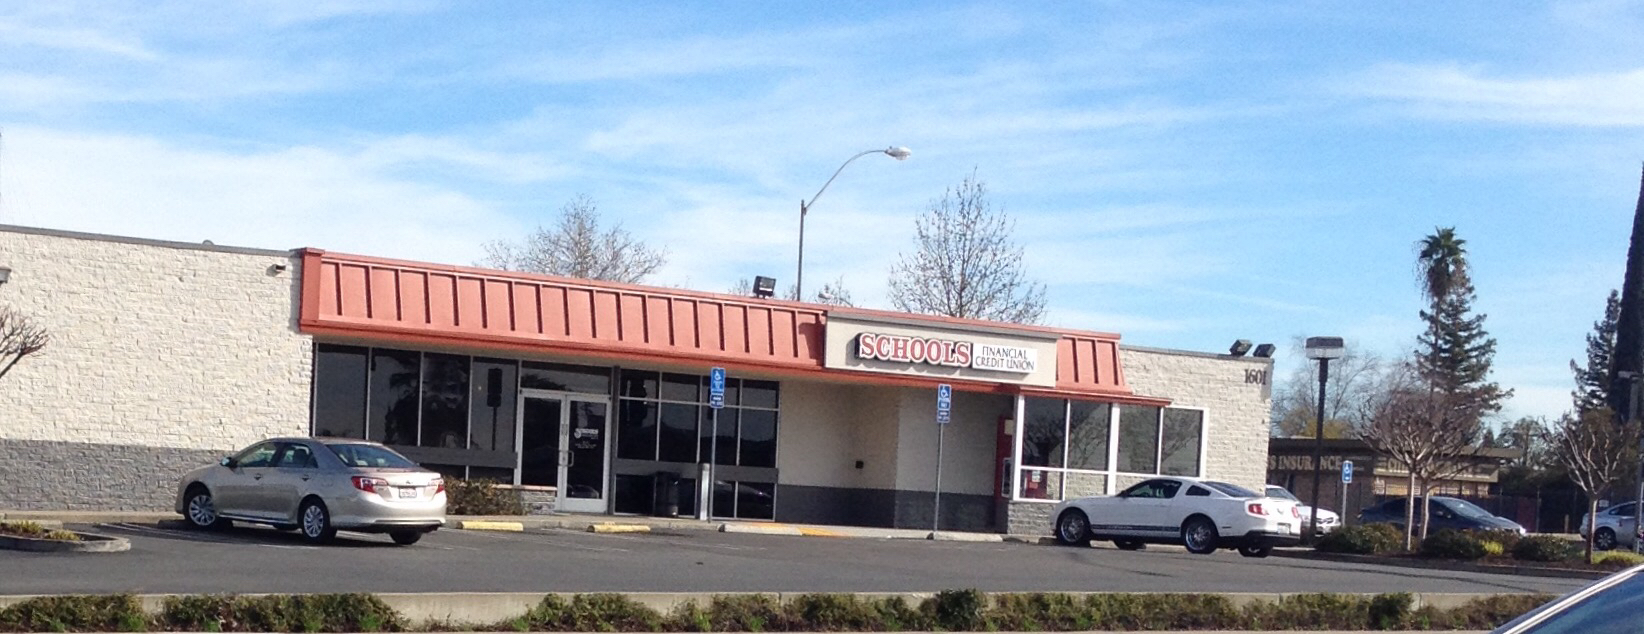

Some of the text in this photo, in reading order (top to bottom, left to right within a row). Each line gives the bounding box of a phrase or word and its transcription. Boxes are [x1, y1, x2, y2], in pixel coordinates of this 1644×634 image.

[860, 333, 971, 367] SCHOOLS
[982, 346, 1028, 360] FINANCIAL
[975, 356, 1035, 370] CREDIT UNION
[1244, 368, 1267, 385] 1601
[1278, 455, 1343, 470] INSURNCE
